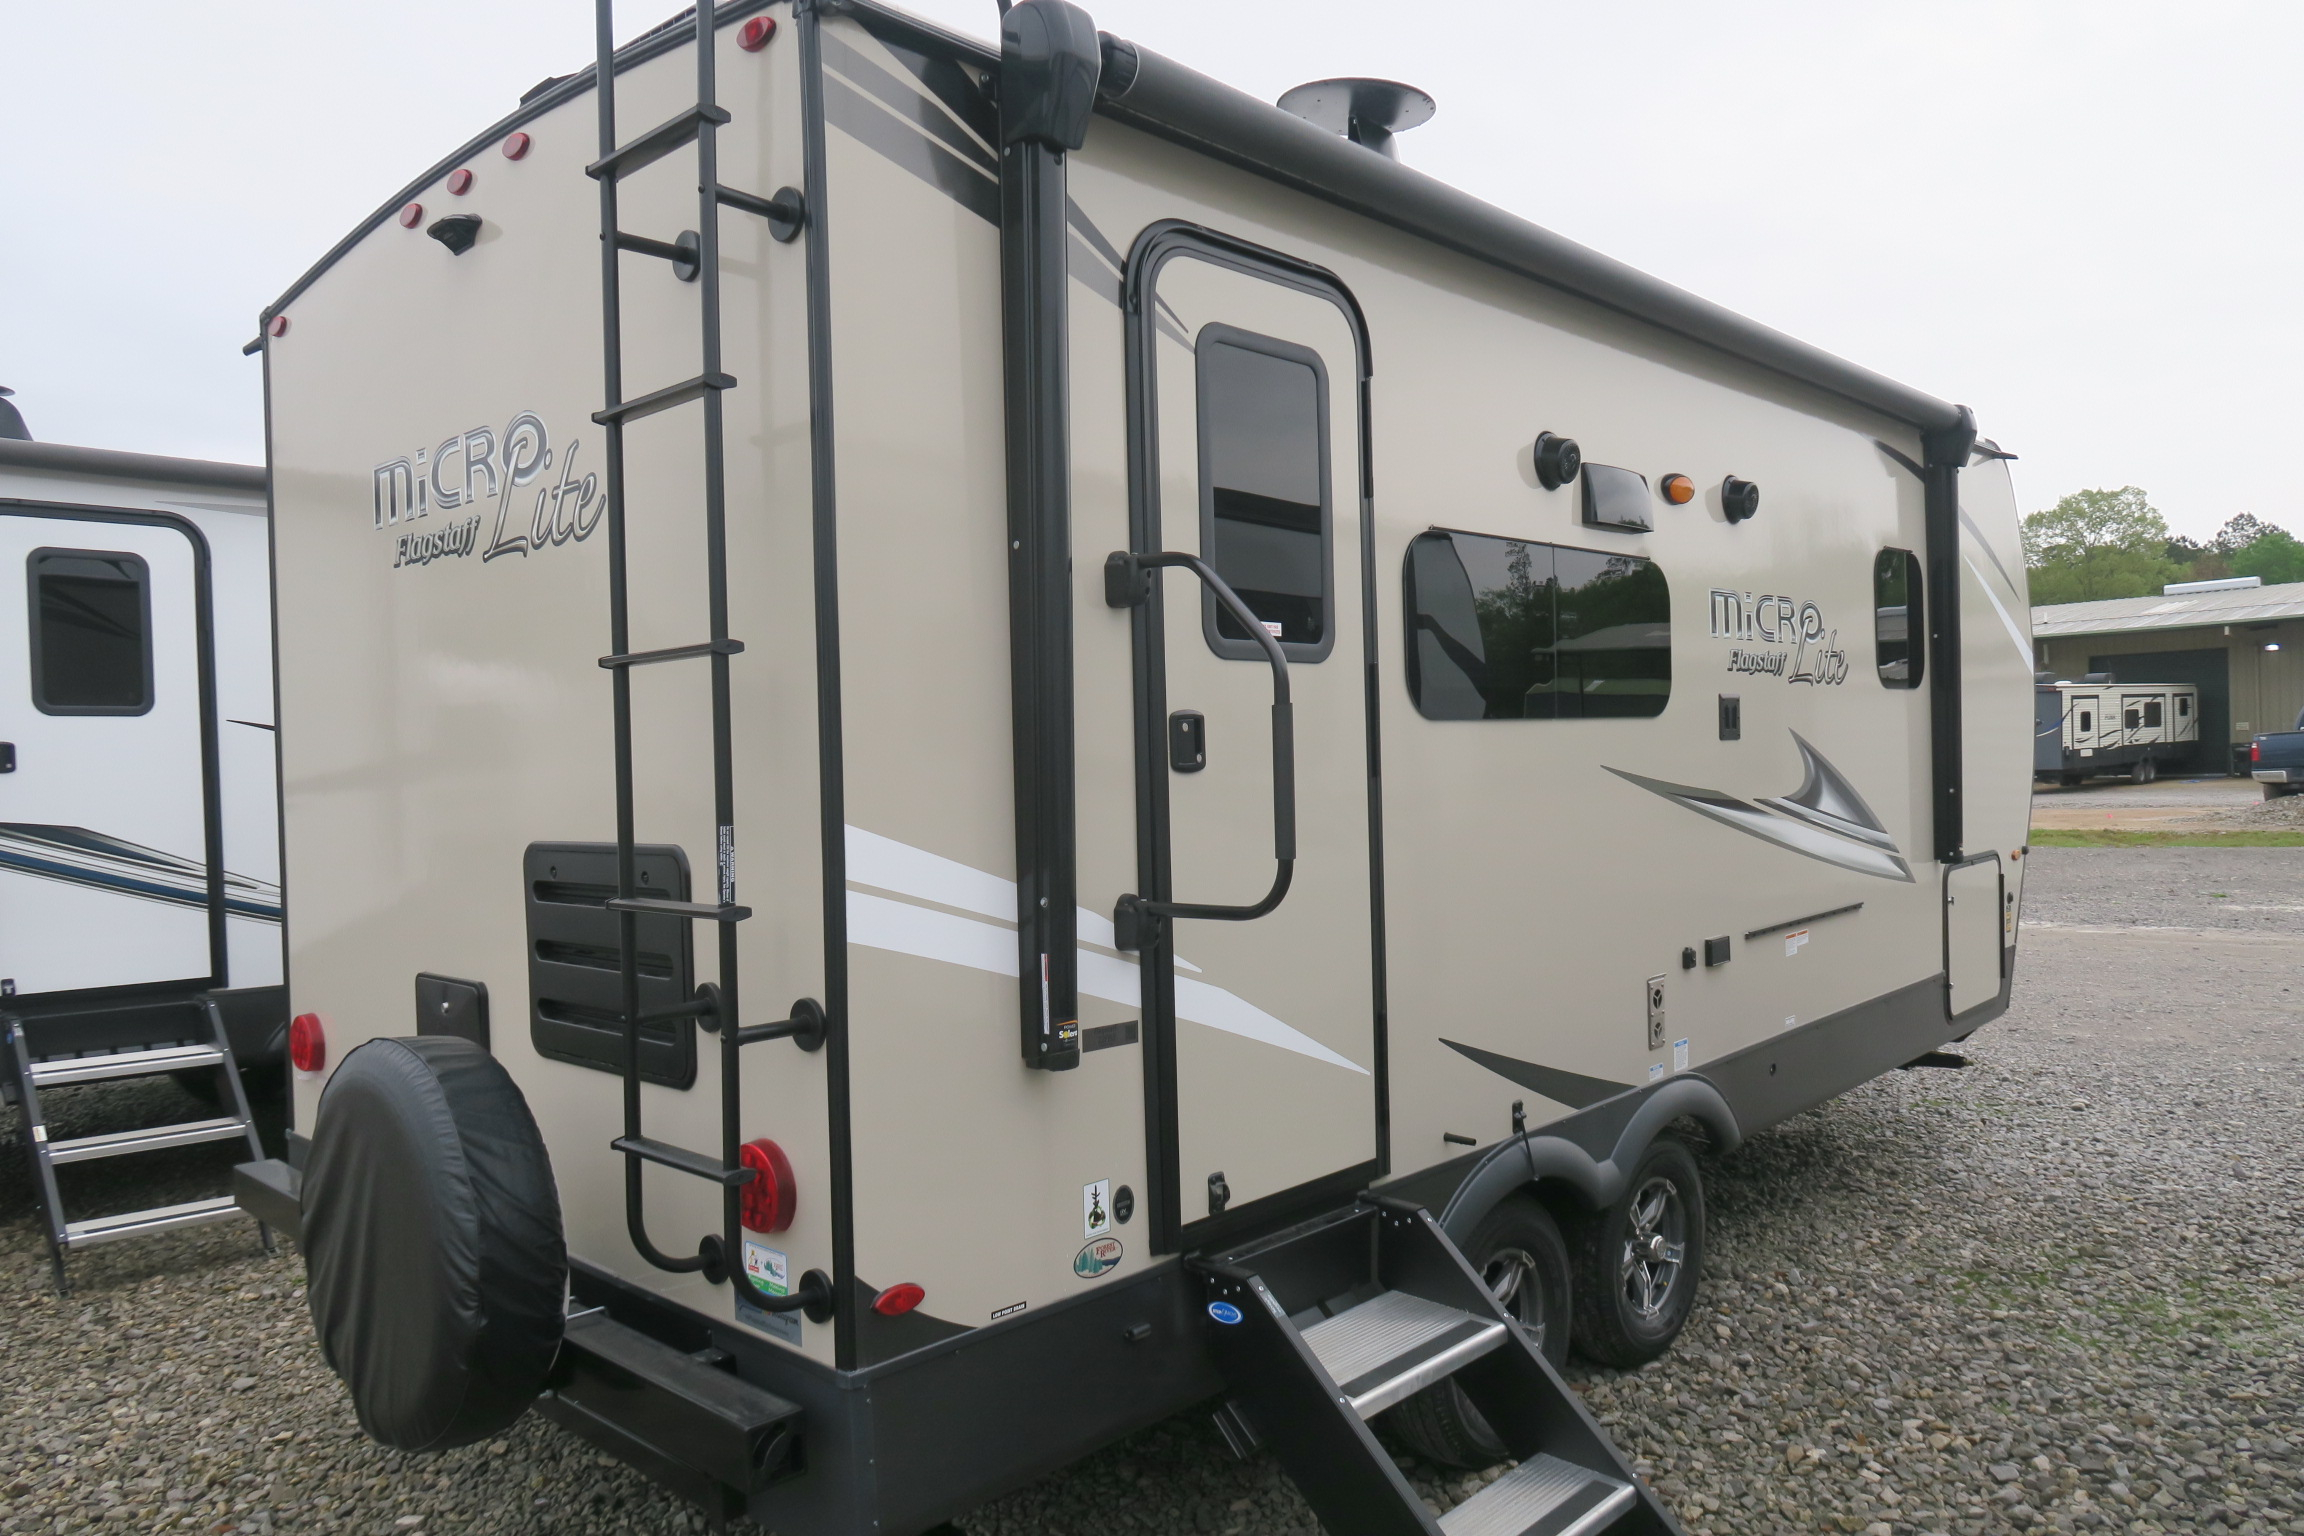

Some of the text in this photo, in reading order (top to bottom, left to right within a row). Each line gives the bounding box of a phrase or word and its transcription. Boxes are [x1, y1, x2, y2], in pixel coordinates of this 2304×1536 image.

[482, 437, 607, 563] Lite
[393, 514, 481, 568] Flagstaff
[1727, 648, 1787, 677] Flagstaff
[1788, 615, 1849, 686] Lite
